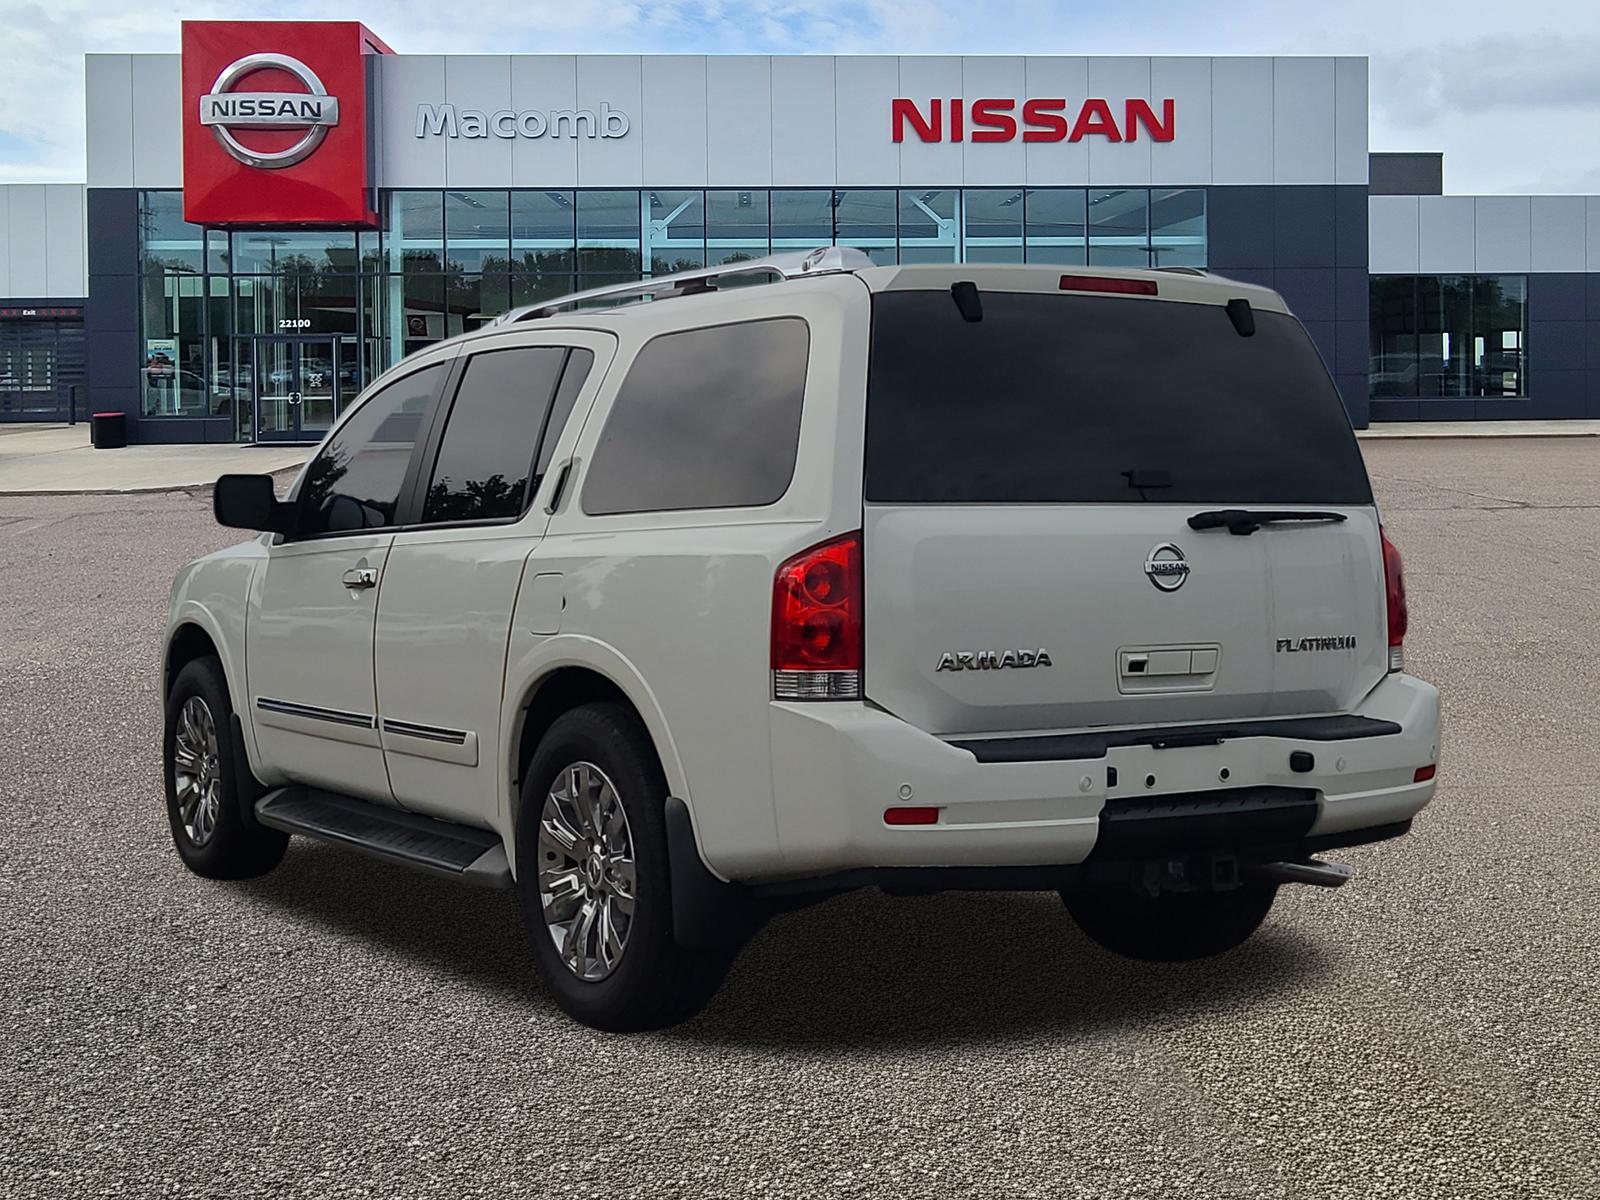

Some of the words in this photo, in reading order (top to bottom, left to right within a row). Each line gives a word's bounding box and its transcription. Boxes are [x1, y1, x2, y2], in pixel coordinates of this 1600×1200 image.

[211, 100, 323, 117] NISSAN
[415, 102, 630, 138] Macomb
[892, 98, 1175, 143] NISSAN
[279, 319, 311, 328] 22100
[1151, 562, 1186, 572] NISSAN
[1276, 636, 1357, 653] PLATINUM
[936, 647, 1053, 672] ARMADA
